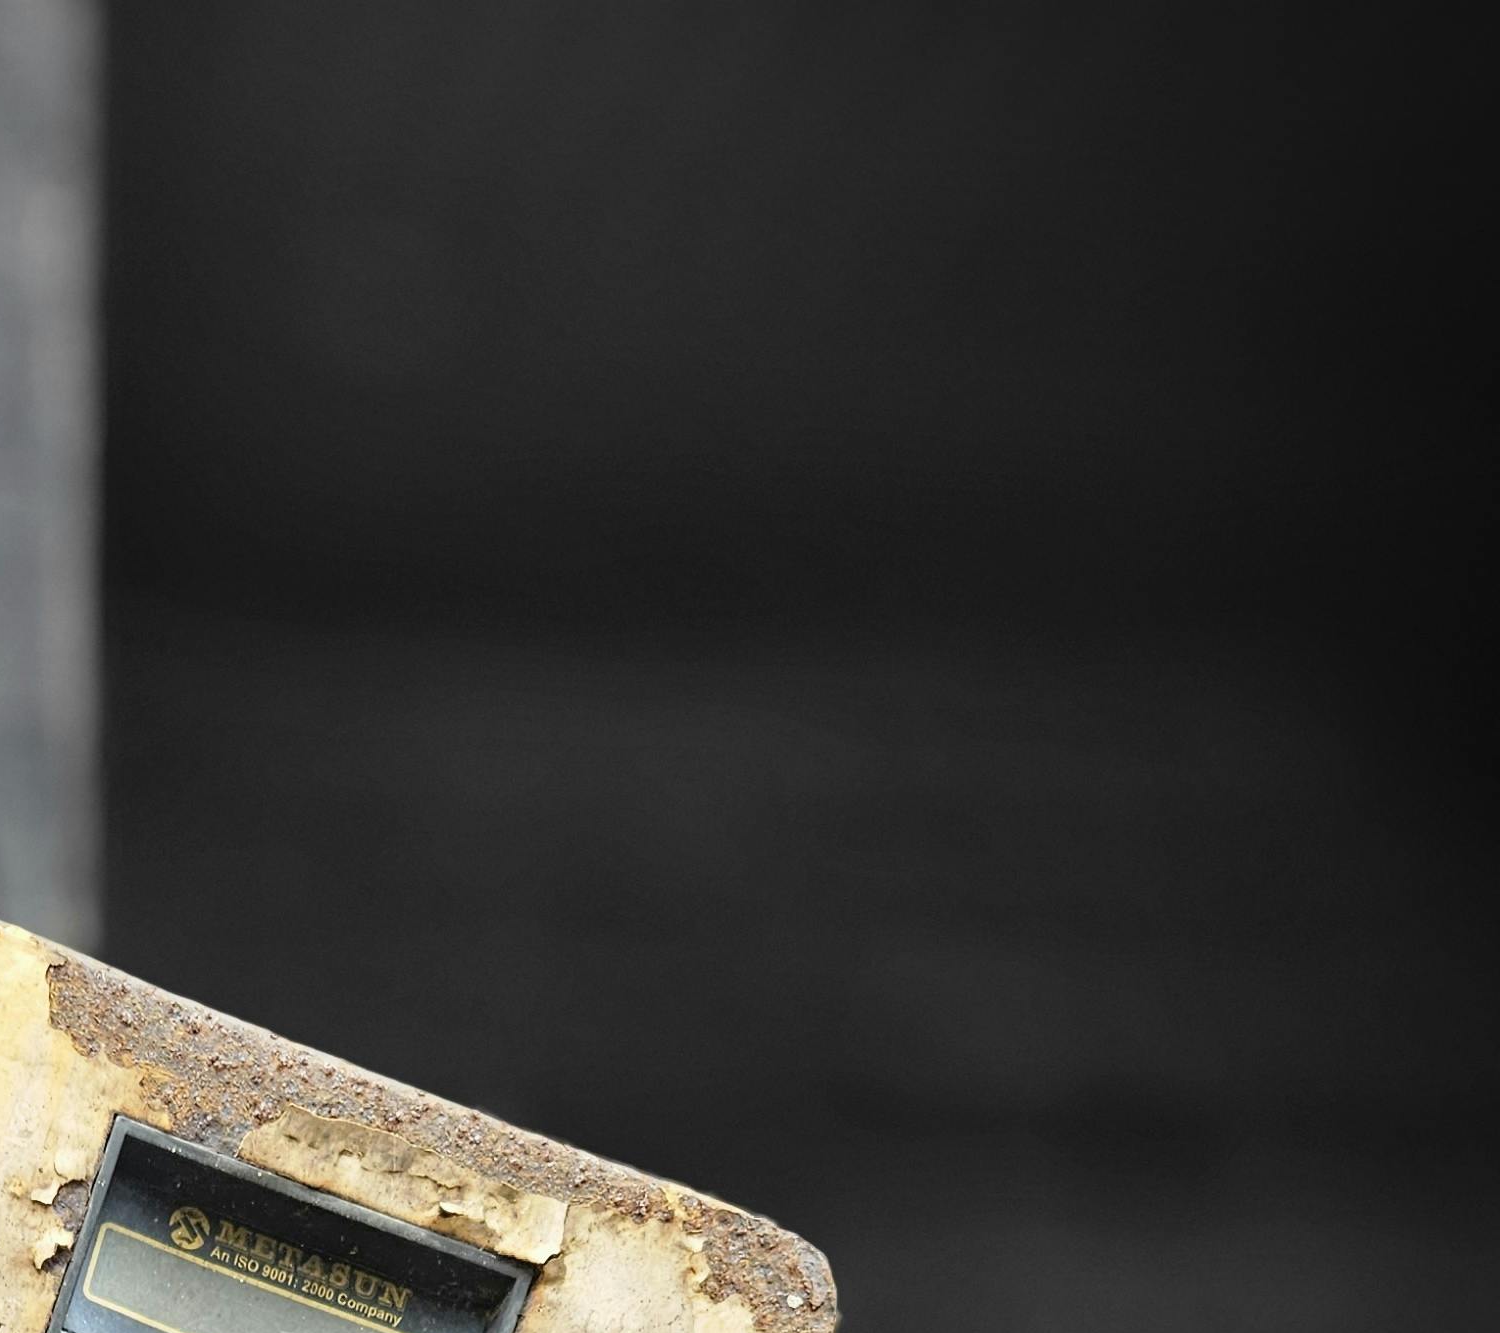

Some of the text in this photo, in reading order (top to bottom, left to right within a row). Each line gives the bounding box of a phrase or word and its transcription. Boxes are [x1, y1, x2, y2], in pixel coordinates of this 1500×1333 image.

[210, 1246, 230, 1264] An
[233, 1254, 260, 1274] ISO
[301, 1279, 334, 1301] 2000
[337, 1293, 403, 1328] Company
[214, 1219, 413, 1311] METASUN
